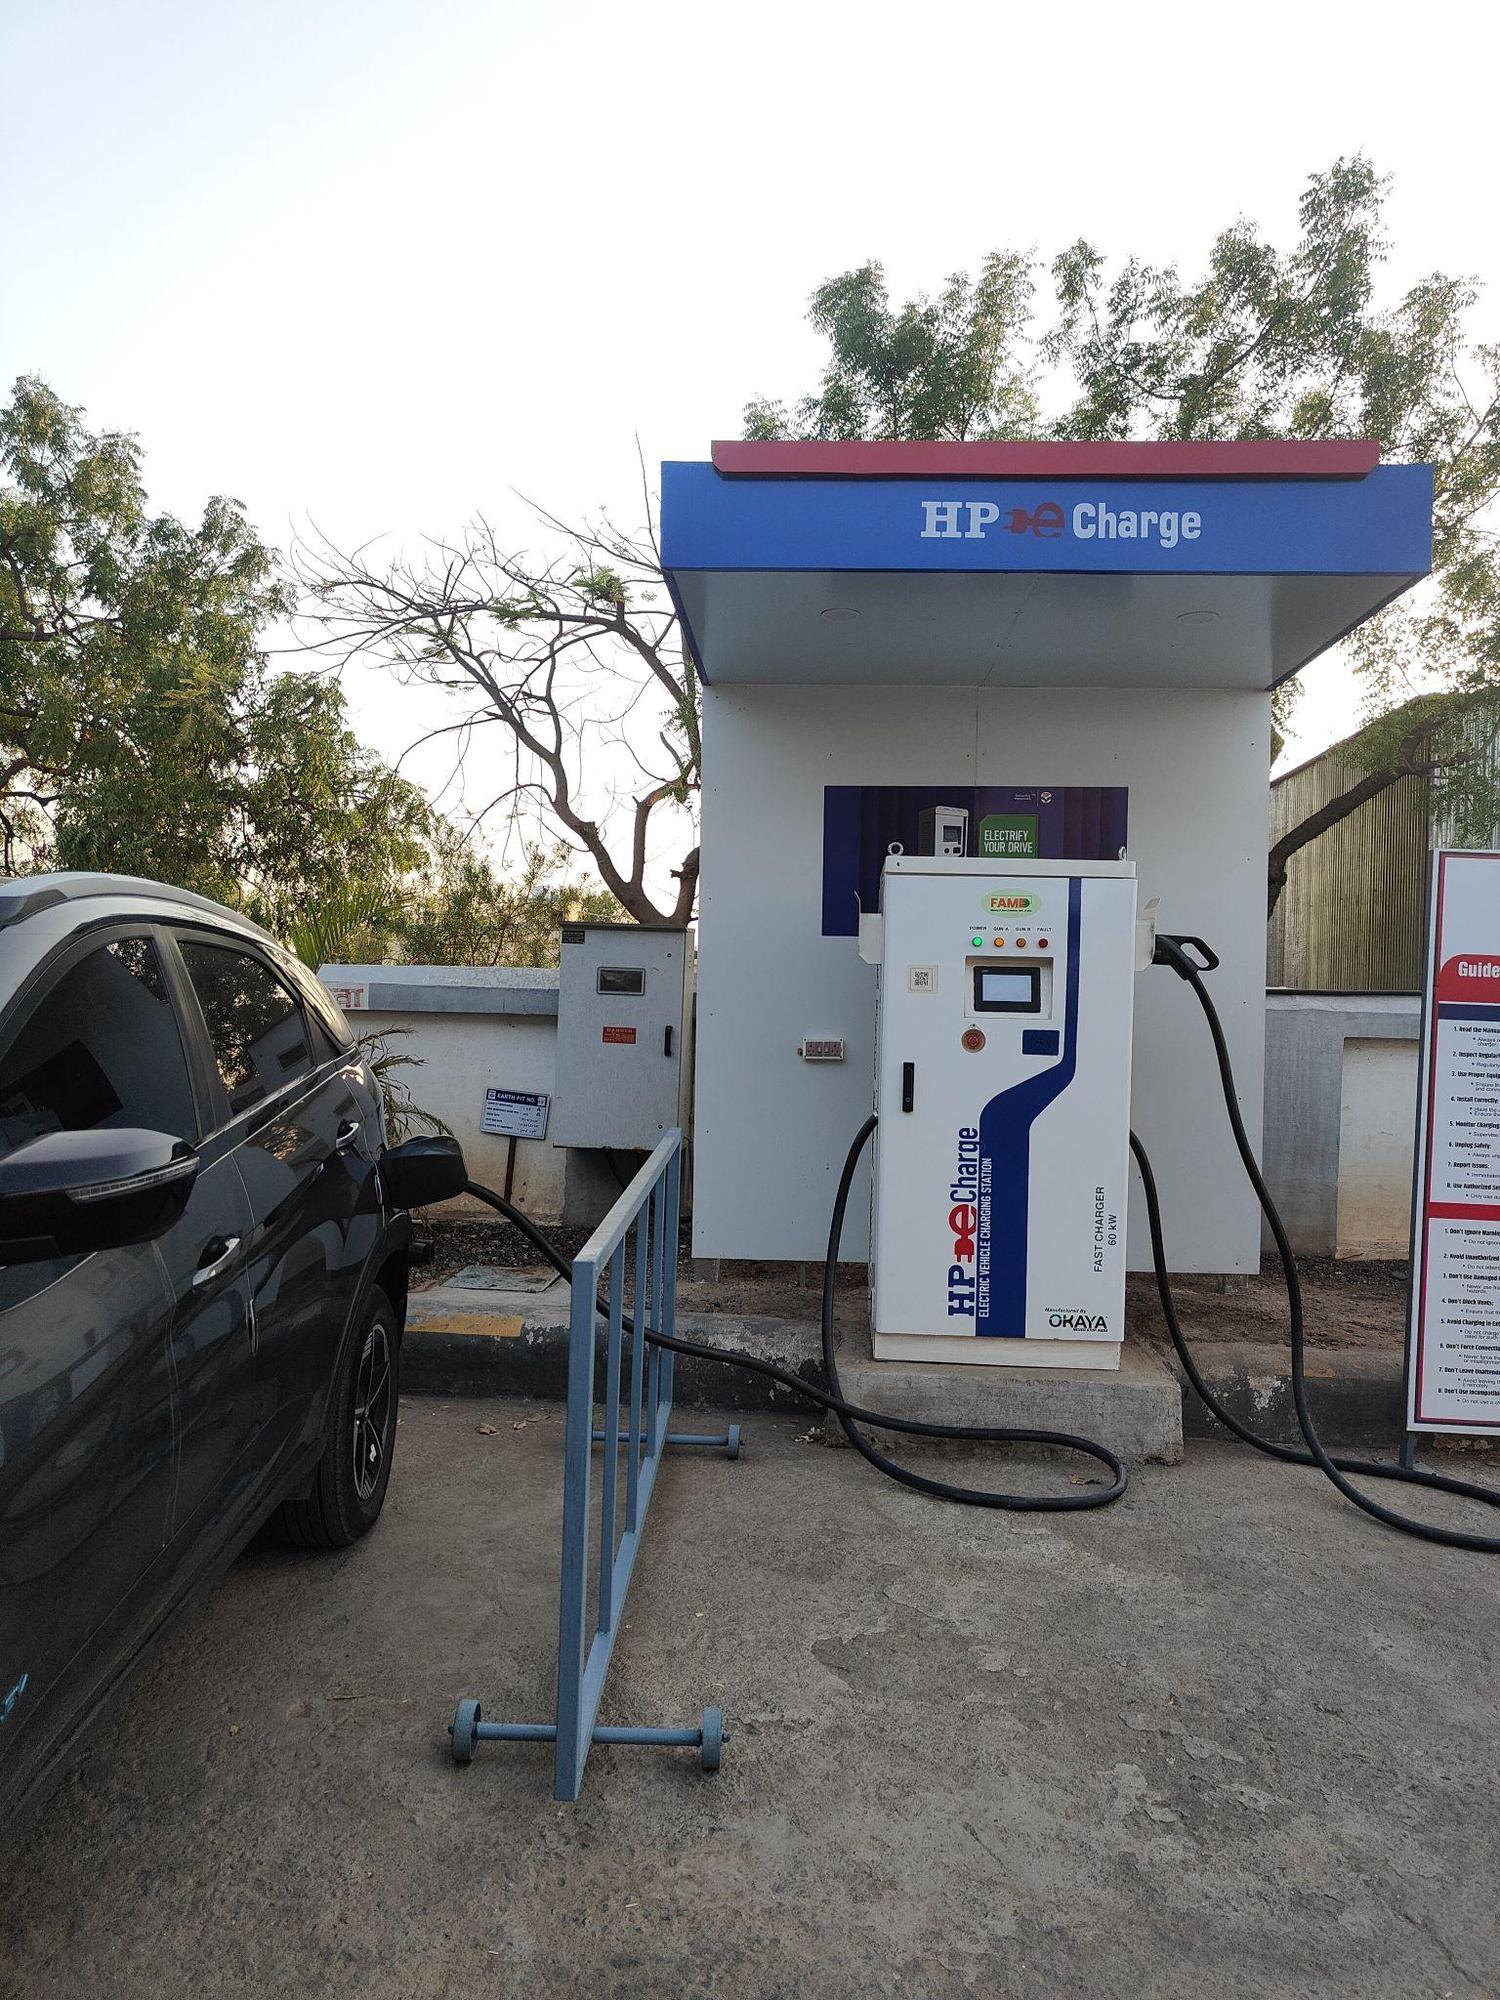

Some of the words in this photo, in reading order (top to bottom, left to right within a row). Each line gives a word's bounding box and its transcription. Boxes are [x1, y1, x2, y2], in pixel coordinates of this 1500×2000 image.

[920, 501, 1000, 538] HP
[1028, 502, 1065, 538] e
[1072, 502, 1201, 549] Charge
[984, 830, 1028, 841] ELECTRIFY
[984, 842, 1005, 853] YOUR
[1008, 842, 1033, 853] DRIVE
[950, 1127, 981, 1203] Charge
[981, 1158, 992, 1193] STATION
[949, 1204, 977, 1236] e
[980, 1196, 991, 1239] CHARGING
[1094, 1187, 1104, 1242] CHARGER
[1108, 1214, 1117, 1230] kW
[1108, 1233, 1117, 1246] 60
[980, 1241, 990, 1275] VEHICLE
[1094, 1244, 1103, 1273] FAST
[947, 1264, 975, 1317] HP
[979, 1278, 990, 1318] ELECTRIC
[1049, 1314, 1107, 1329] OKAYA
